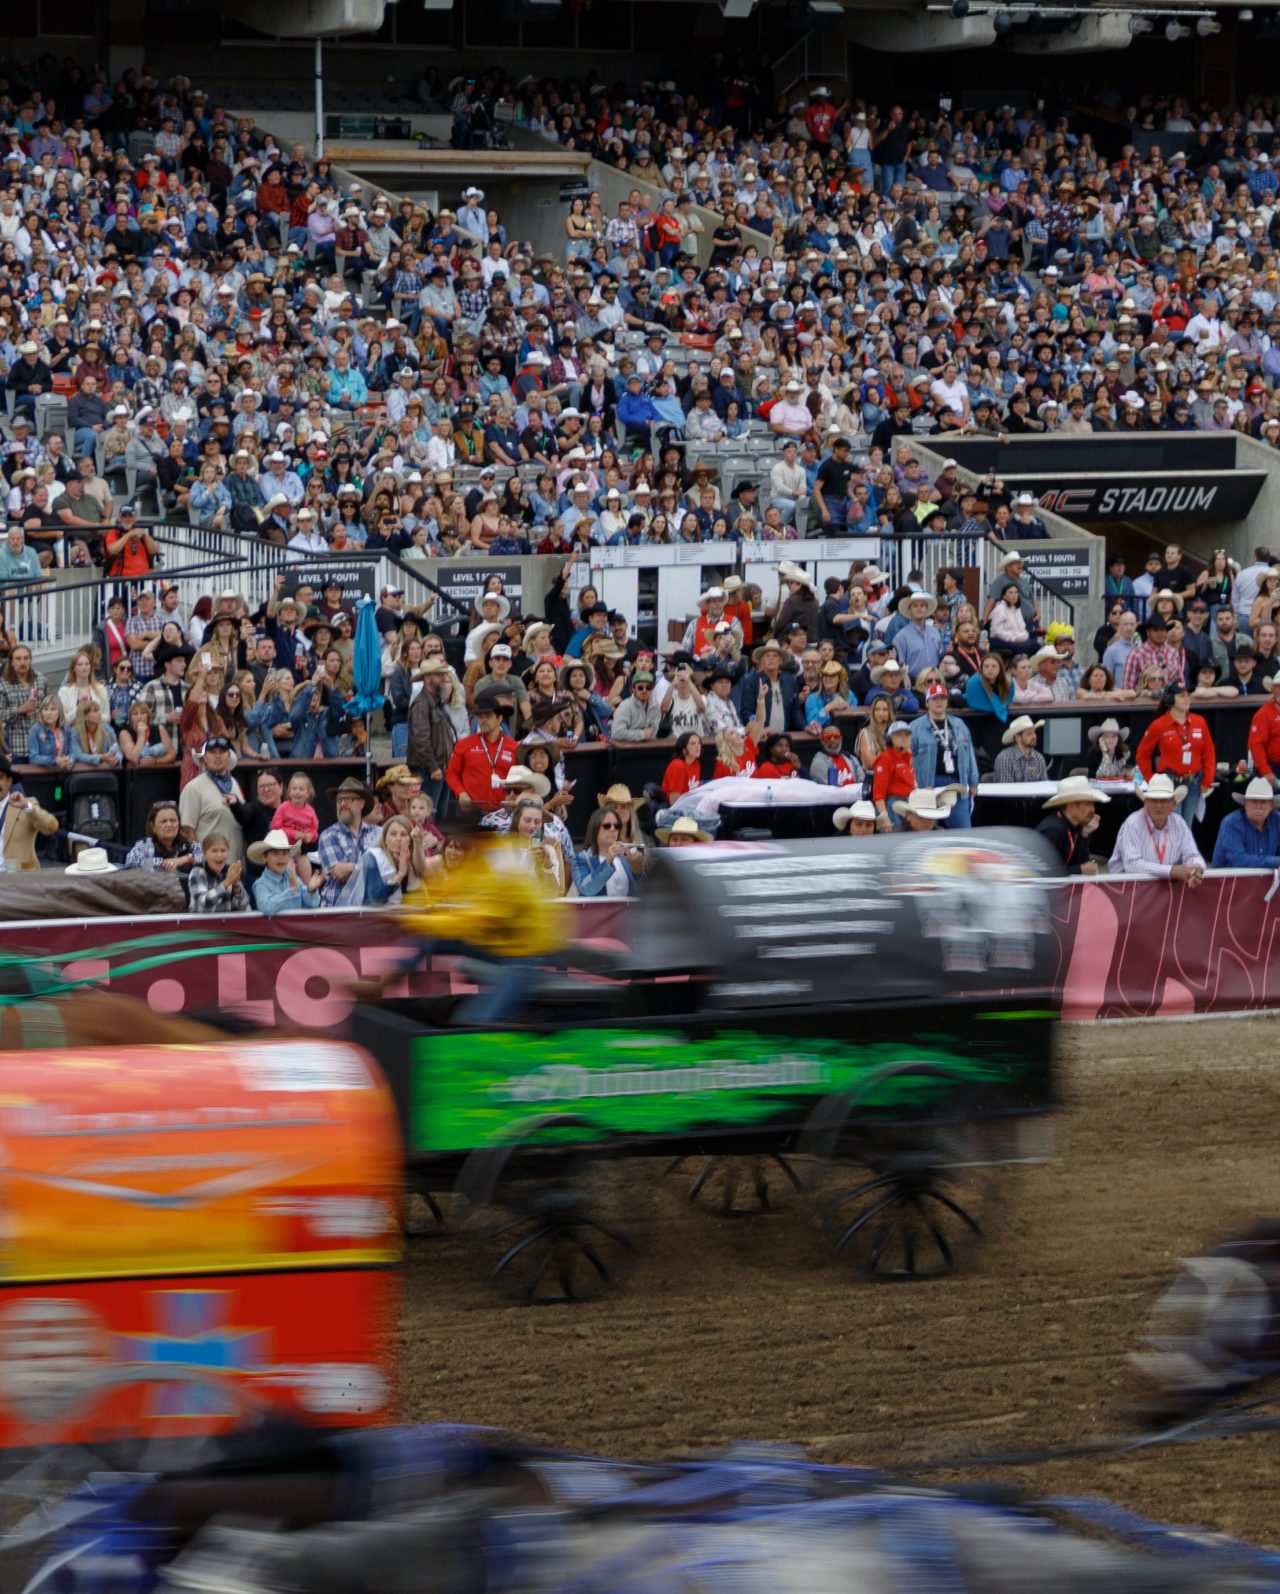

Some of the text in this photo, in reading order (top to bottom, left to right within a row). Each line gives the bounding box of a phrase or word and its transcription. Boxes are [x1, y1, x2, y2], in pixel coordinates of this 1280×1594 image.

[1098, 486, 1218, 512] STADIUM
[1053, 554, 1076, 563] SOUTH
[298, 573, 322, 583] LEVEL
[323, 573, 329, 582] 1
[453, 573, 474, 582] LEVEL
[475, 573, 480, 581] 1
